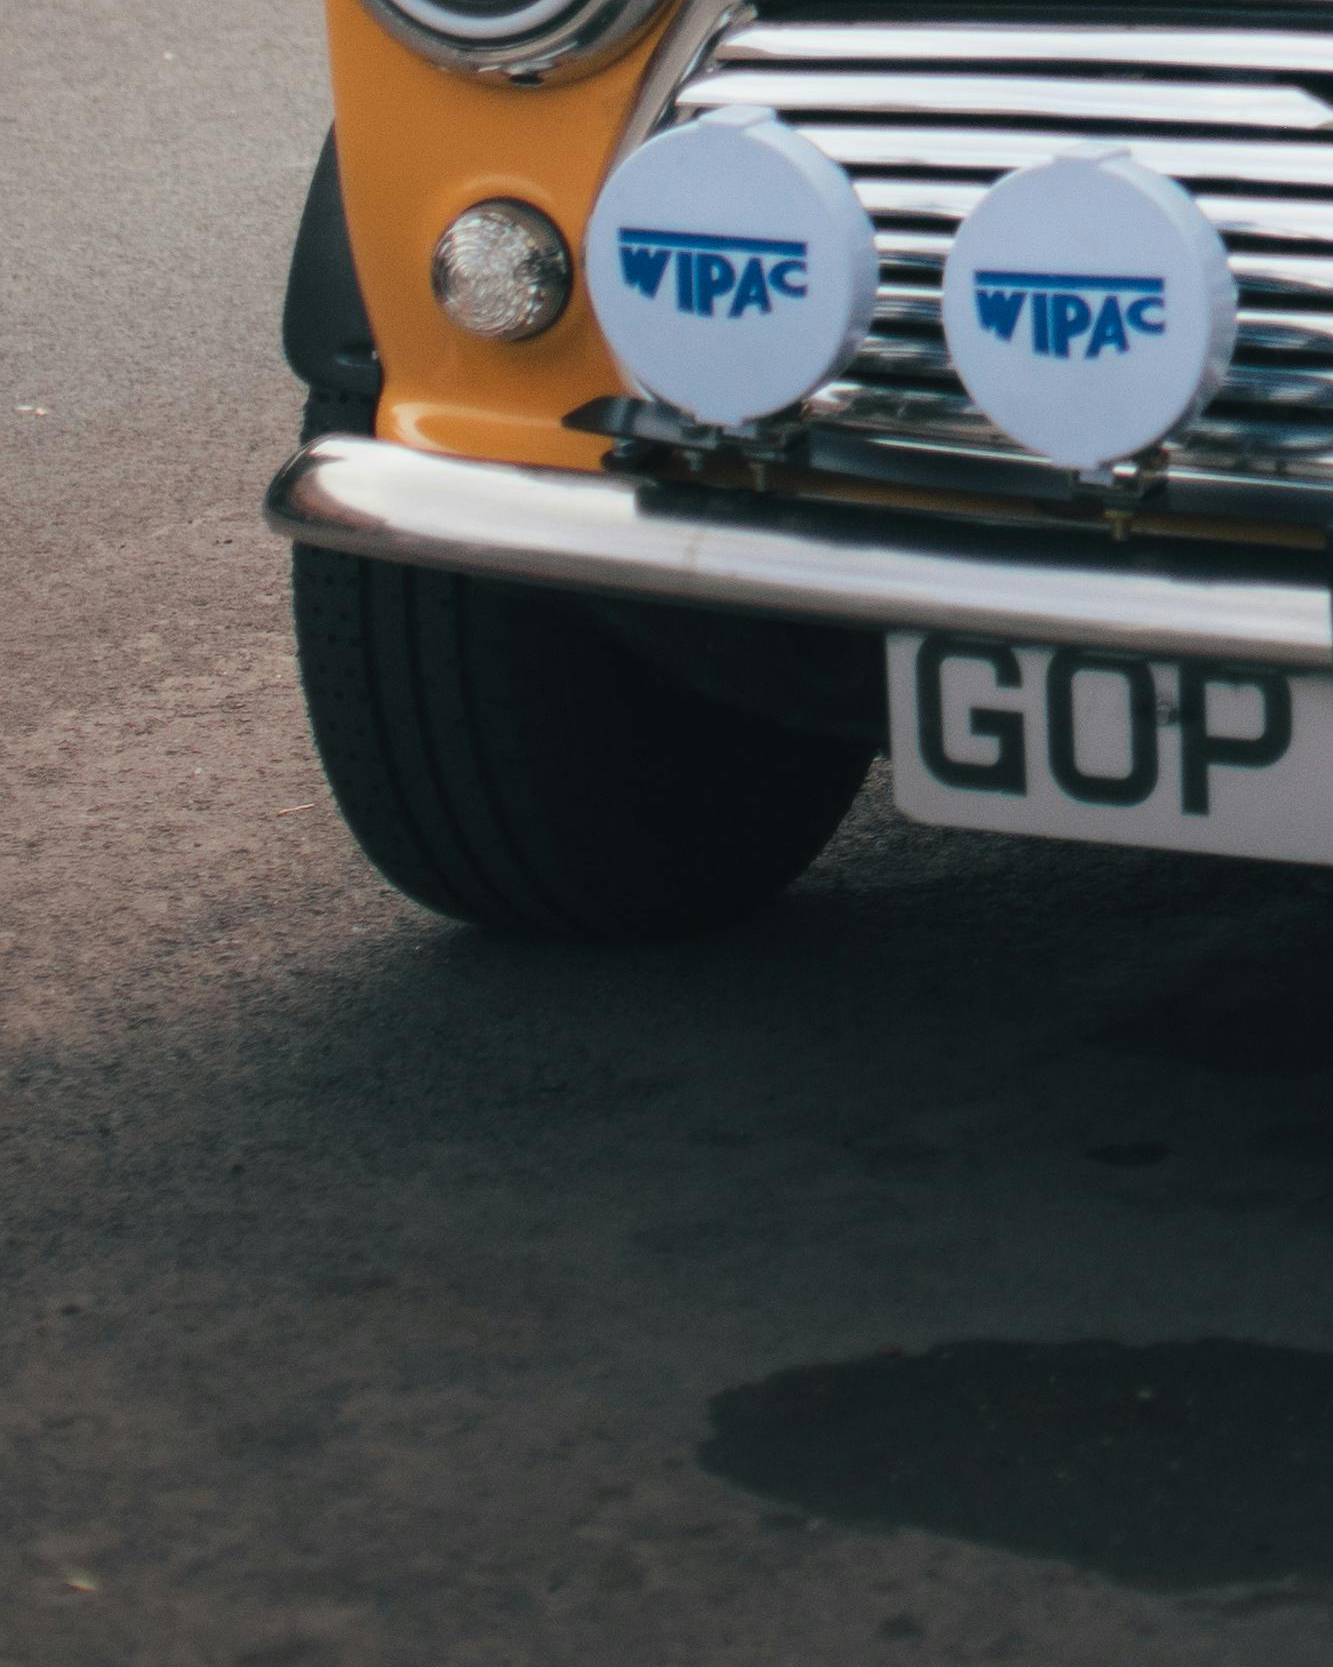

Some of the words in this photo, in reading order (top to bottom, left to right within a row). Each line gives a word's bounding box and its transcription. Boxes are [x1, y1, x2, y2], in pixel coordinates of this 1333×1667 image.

[619, 247, 808, 319] WIPAC
[973, 288, 1166, 360] WIPAC
[915, 635, 1293, 817] GOP
